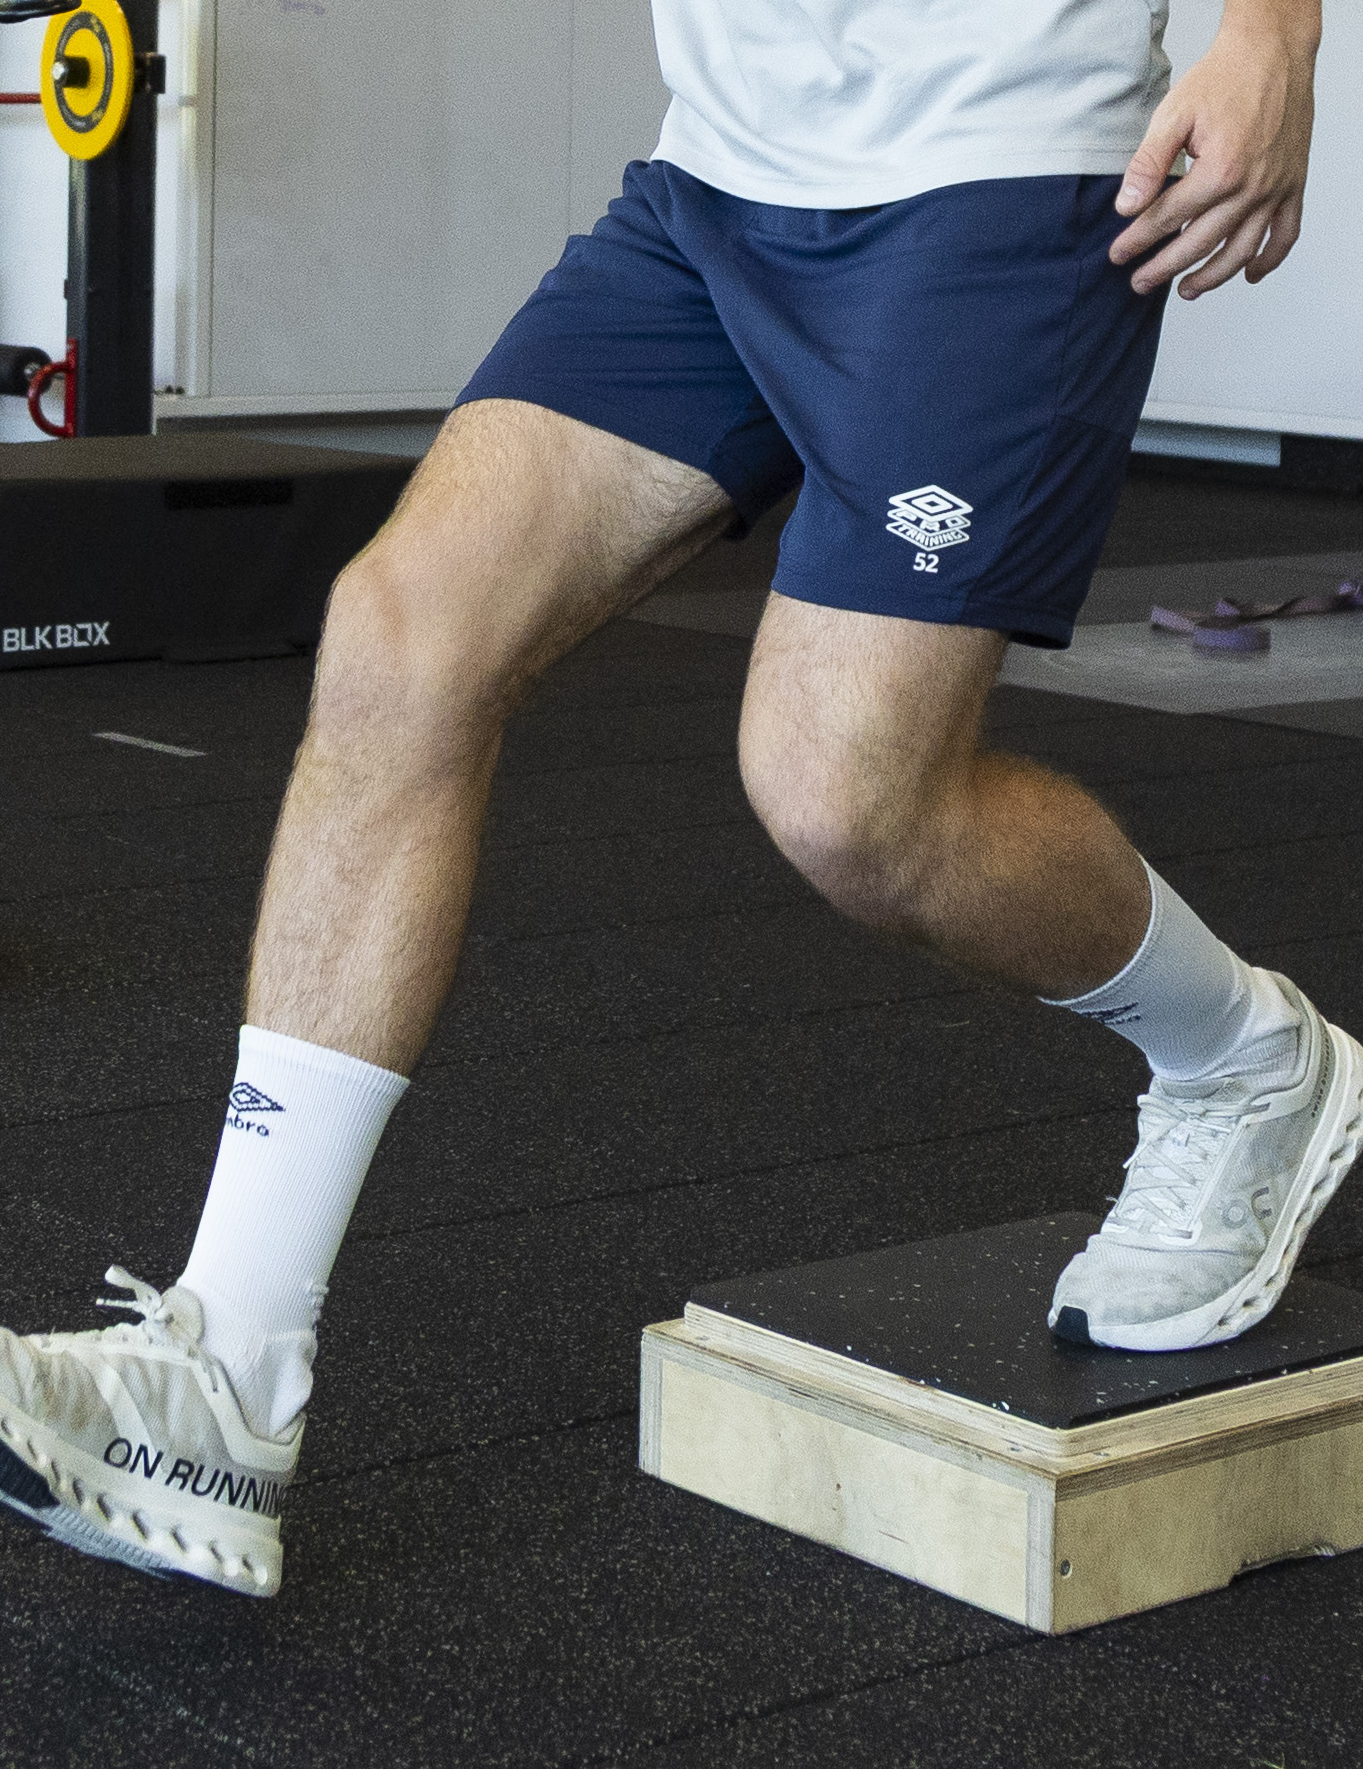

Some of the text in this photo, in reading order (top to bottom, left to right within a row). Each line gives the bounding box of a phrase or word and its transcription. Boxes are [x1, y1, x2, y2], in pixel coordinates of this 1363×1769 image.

[898, 523, 963, 548] TRAINING
[913, 552, 939, 574] 52
[103, 1436, 164, 1479] ON
